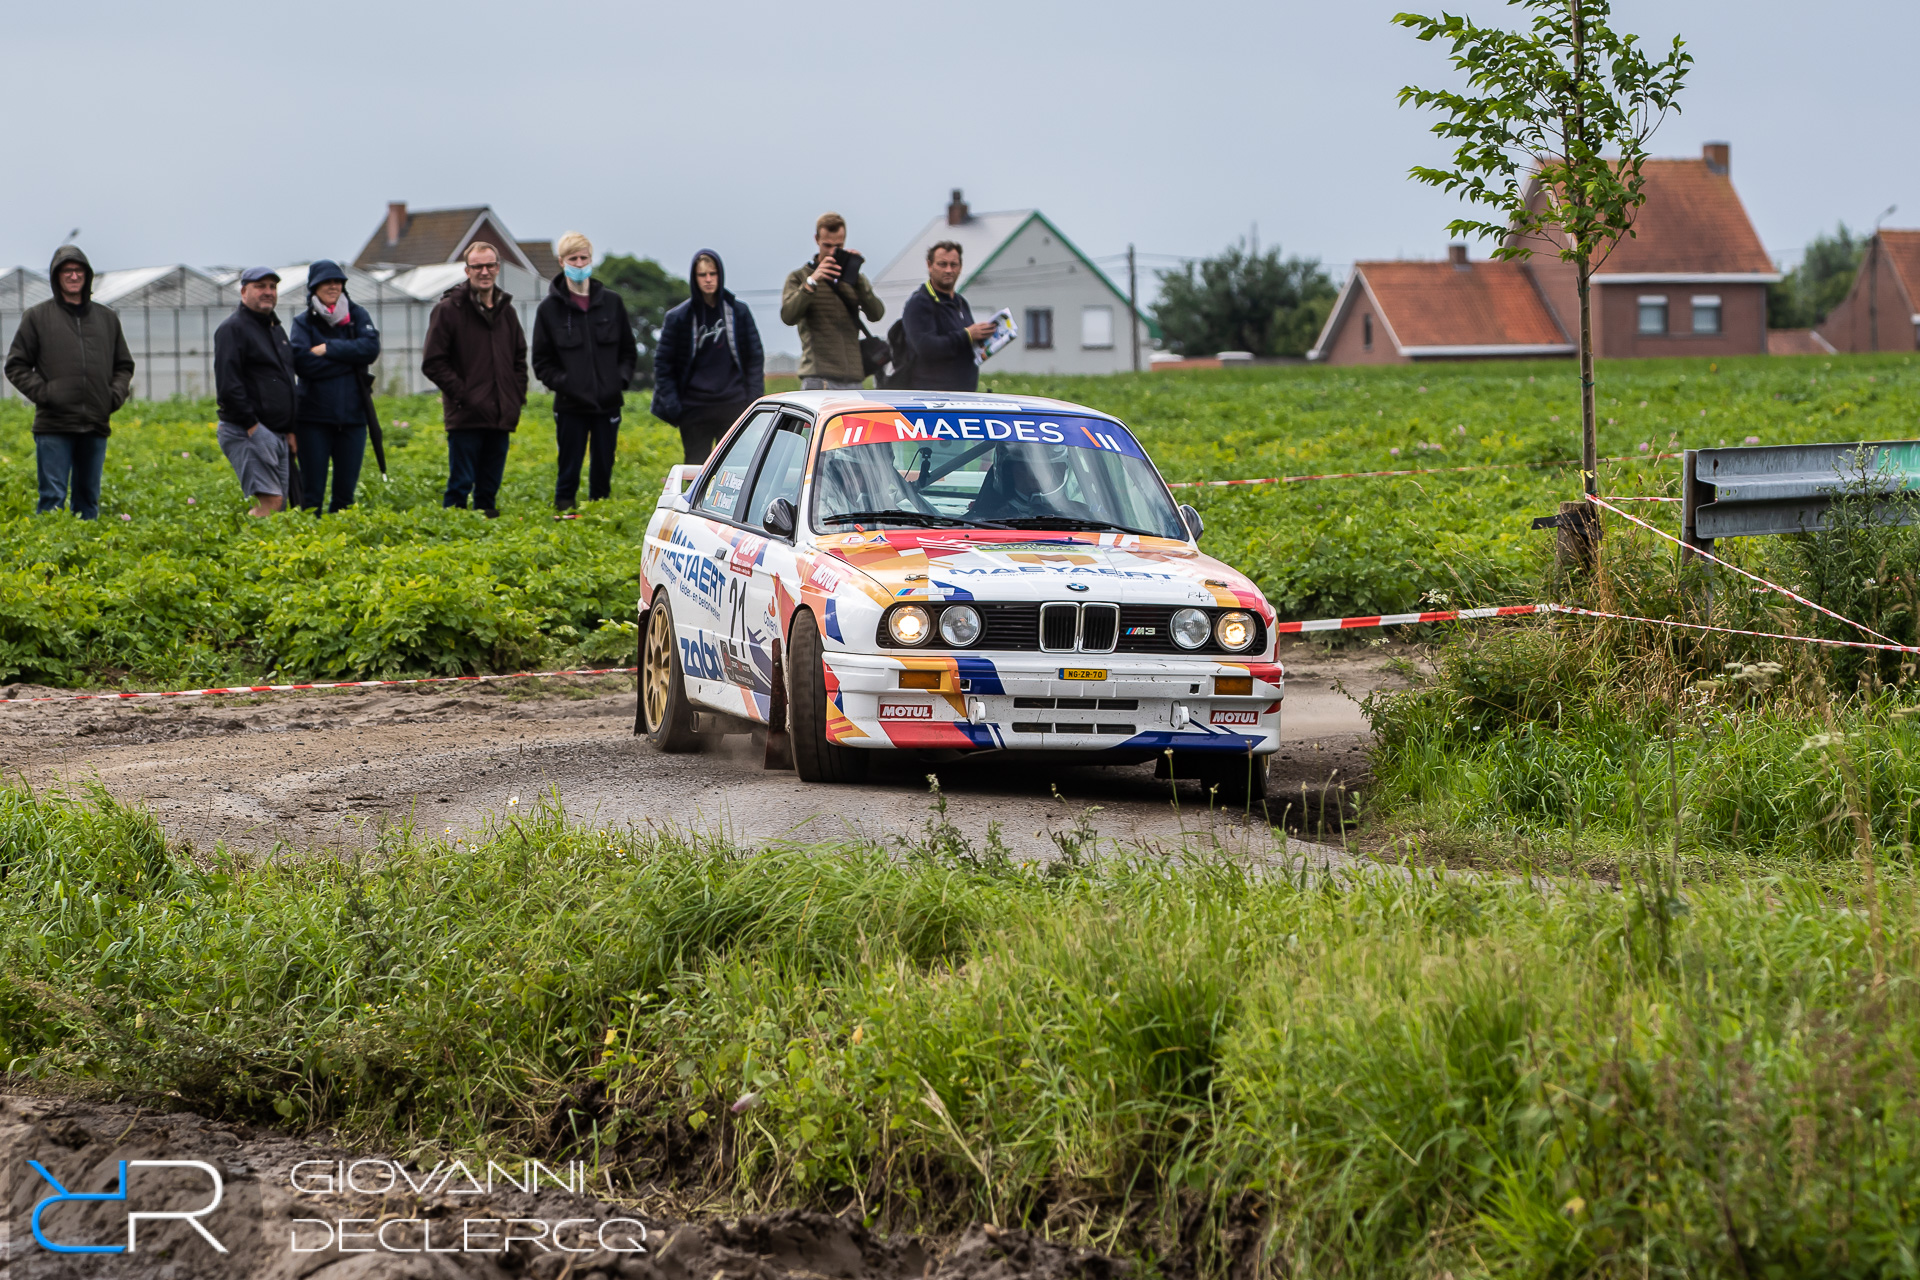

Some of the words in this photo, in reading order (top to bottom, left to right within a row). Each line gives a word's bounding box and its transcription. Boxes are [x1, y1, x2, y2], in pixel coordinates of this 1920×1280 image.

[894, 418, 1064, 443] MAEDES
[811, 563, 840, 592] MOTUL
[949, 566, 1178, 580] MAEYAERT
[729, 577, 746, 659] 21
[1134, 627, 1156, 635] M3
[1068, 670, 1103, 678] NG-ZR-70
[882, 706, 930, 717] MOTUL
[1212, 712, 1257, 723] MOTUL
